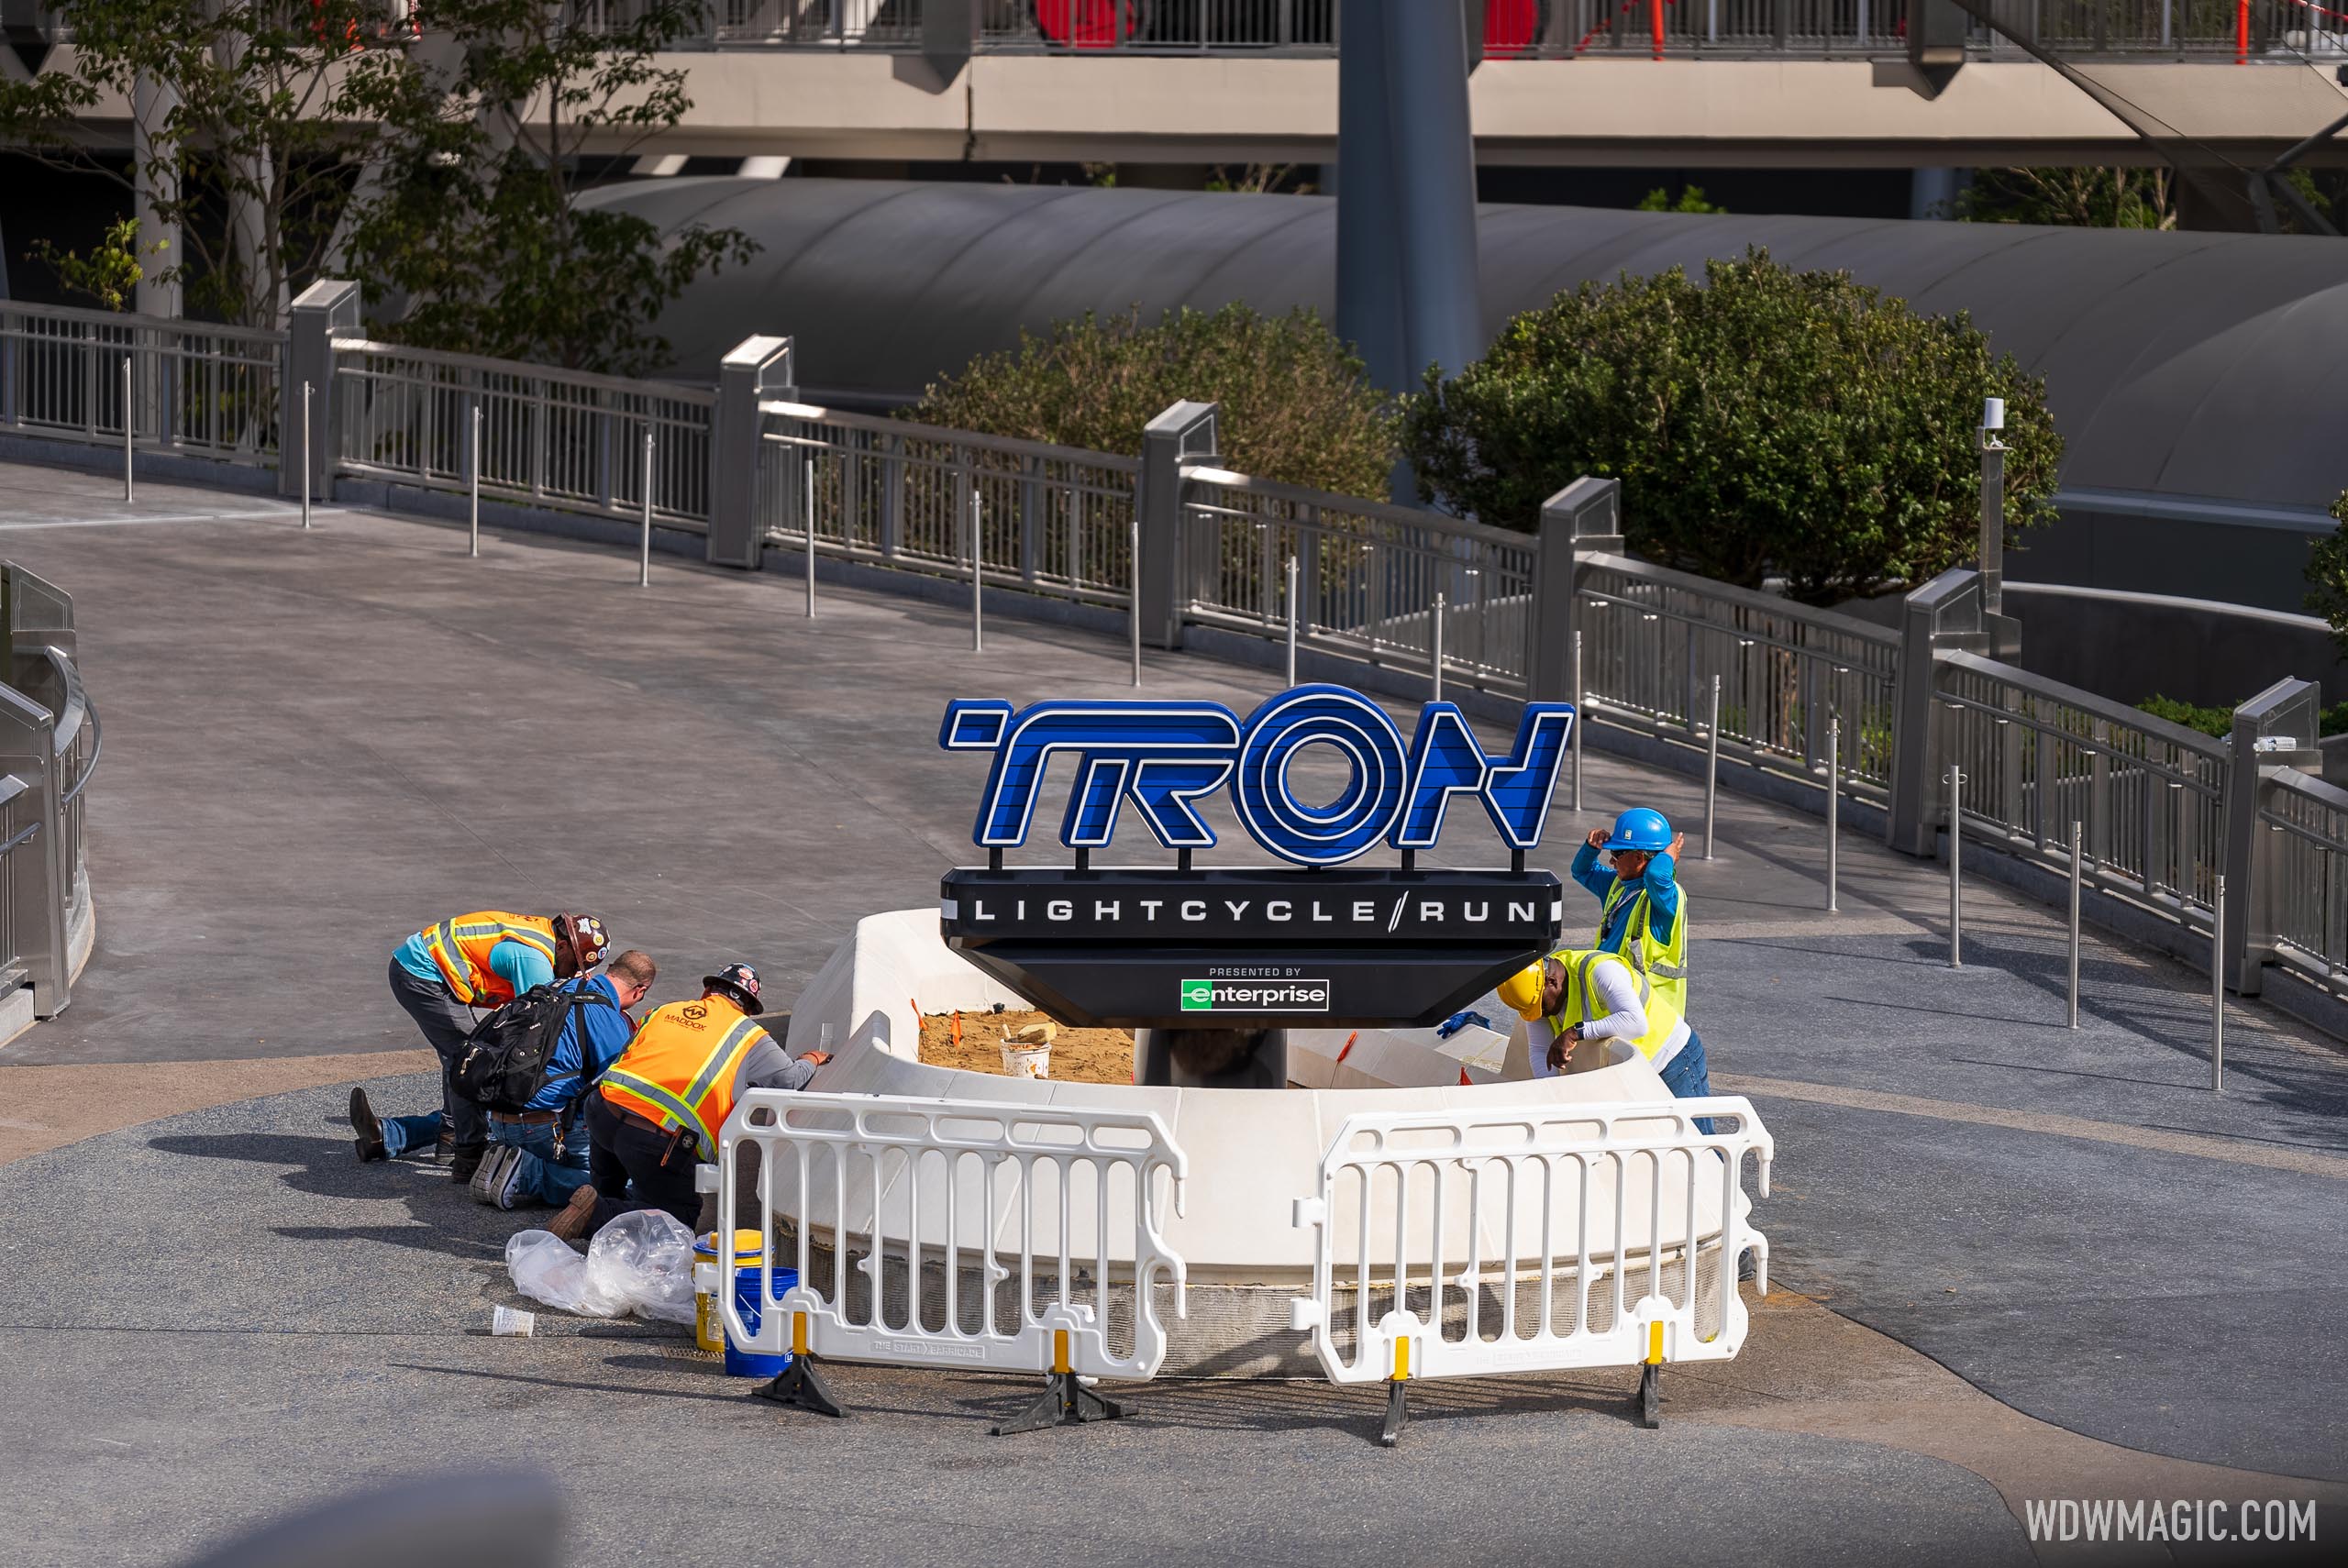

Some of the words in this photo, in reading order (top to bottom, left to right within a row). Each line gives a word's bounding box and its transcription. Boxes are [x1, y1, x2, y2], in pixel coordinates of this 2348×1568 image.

[938, 683, 1575, 867] TRON
[1209, 967, 1280, 977] PRESENTED
[1285, 967, 1301, 977] BY
[1184, 985, 1325, 1006] enterprise
[664, 1014, 707, 1031] MADDOX
